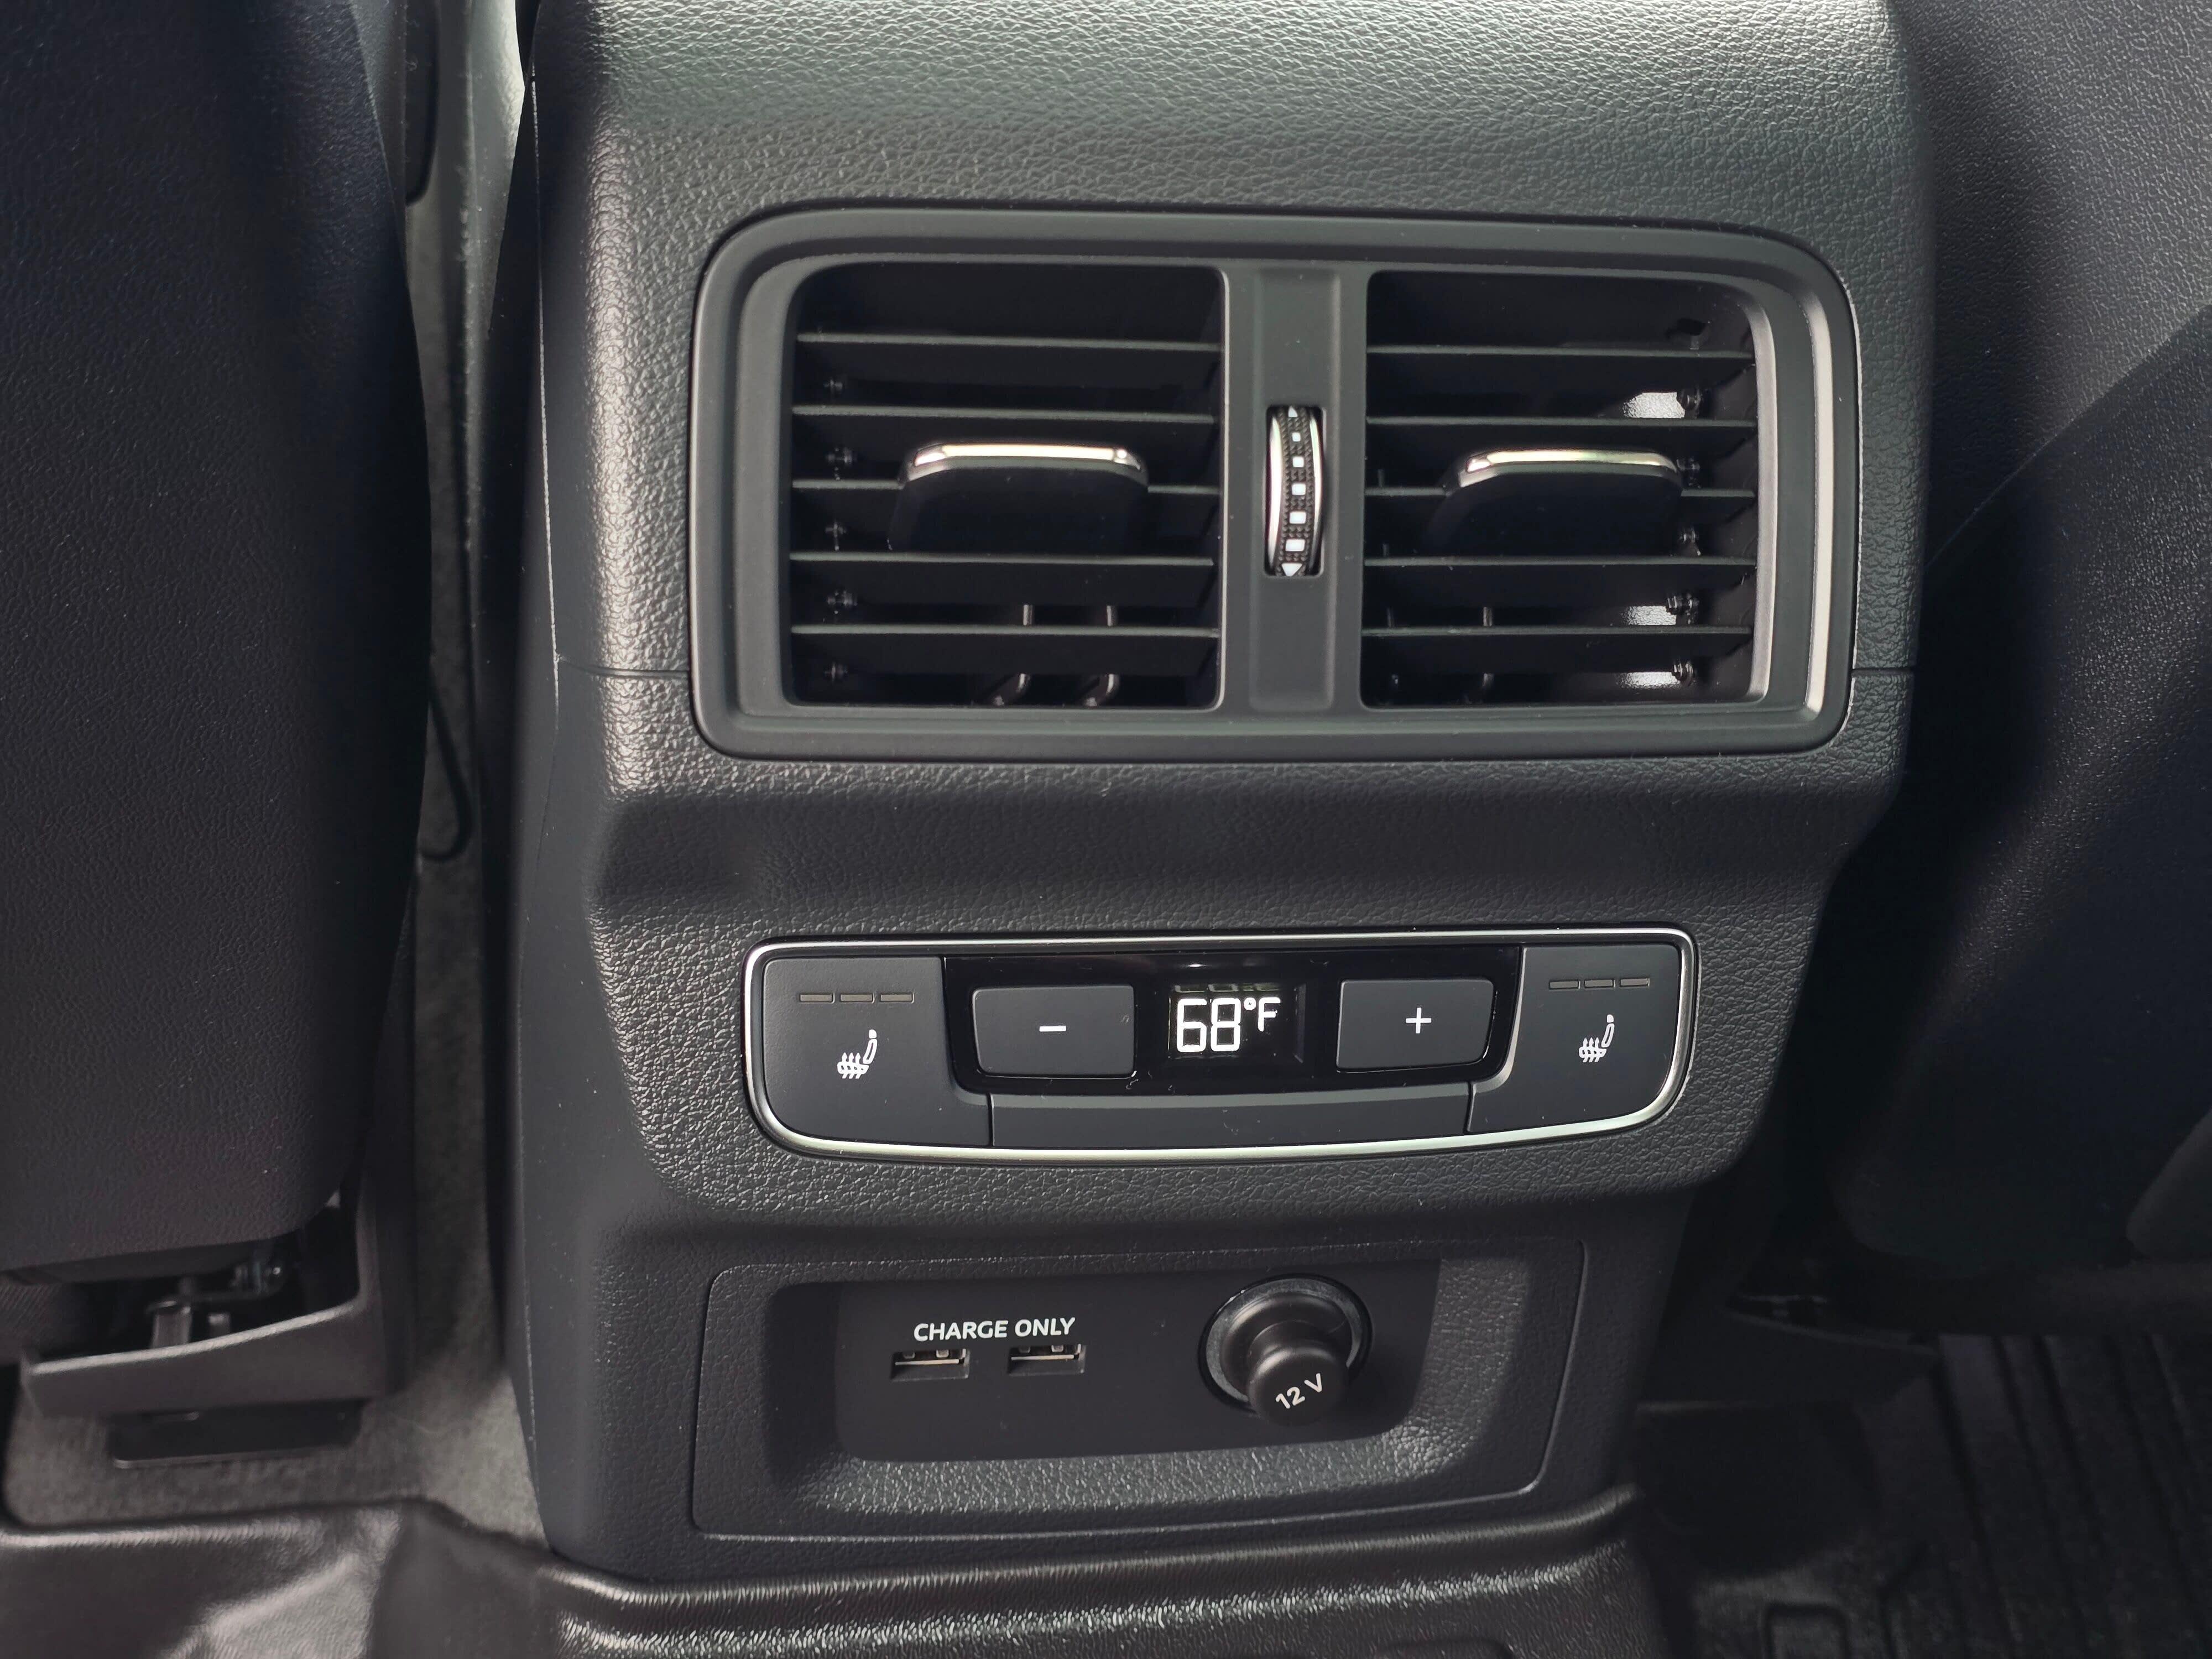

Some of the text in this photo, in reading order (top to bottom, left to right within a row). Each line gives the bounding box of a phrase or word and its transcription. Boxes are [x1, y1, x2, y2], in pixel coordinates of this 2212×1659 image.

[1176, 997, 1281, 1052] 68°F
[914, 1317, 1076, 1342] CHARGE ONLY
[1275, 1373, 1322, 1409] 12 V
